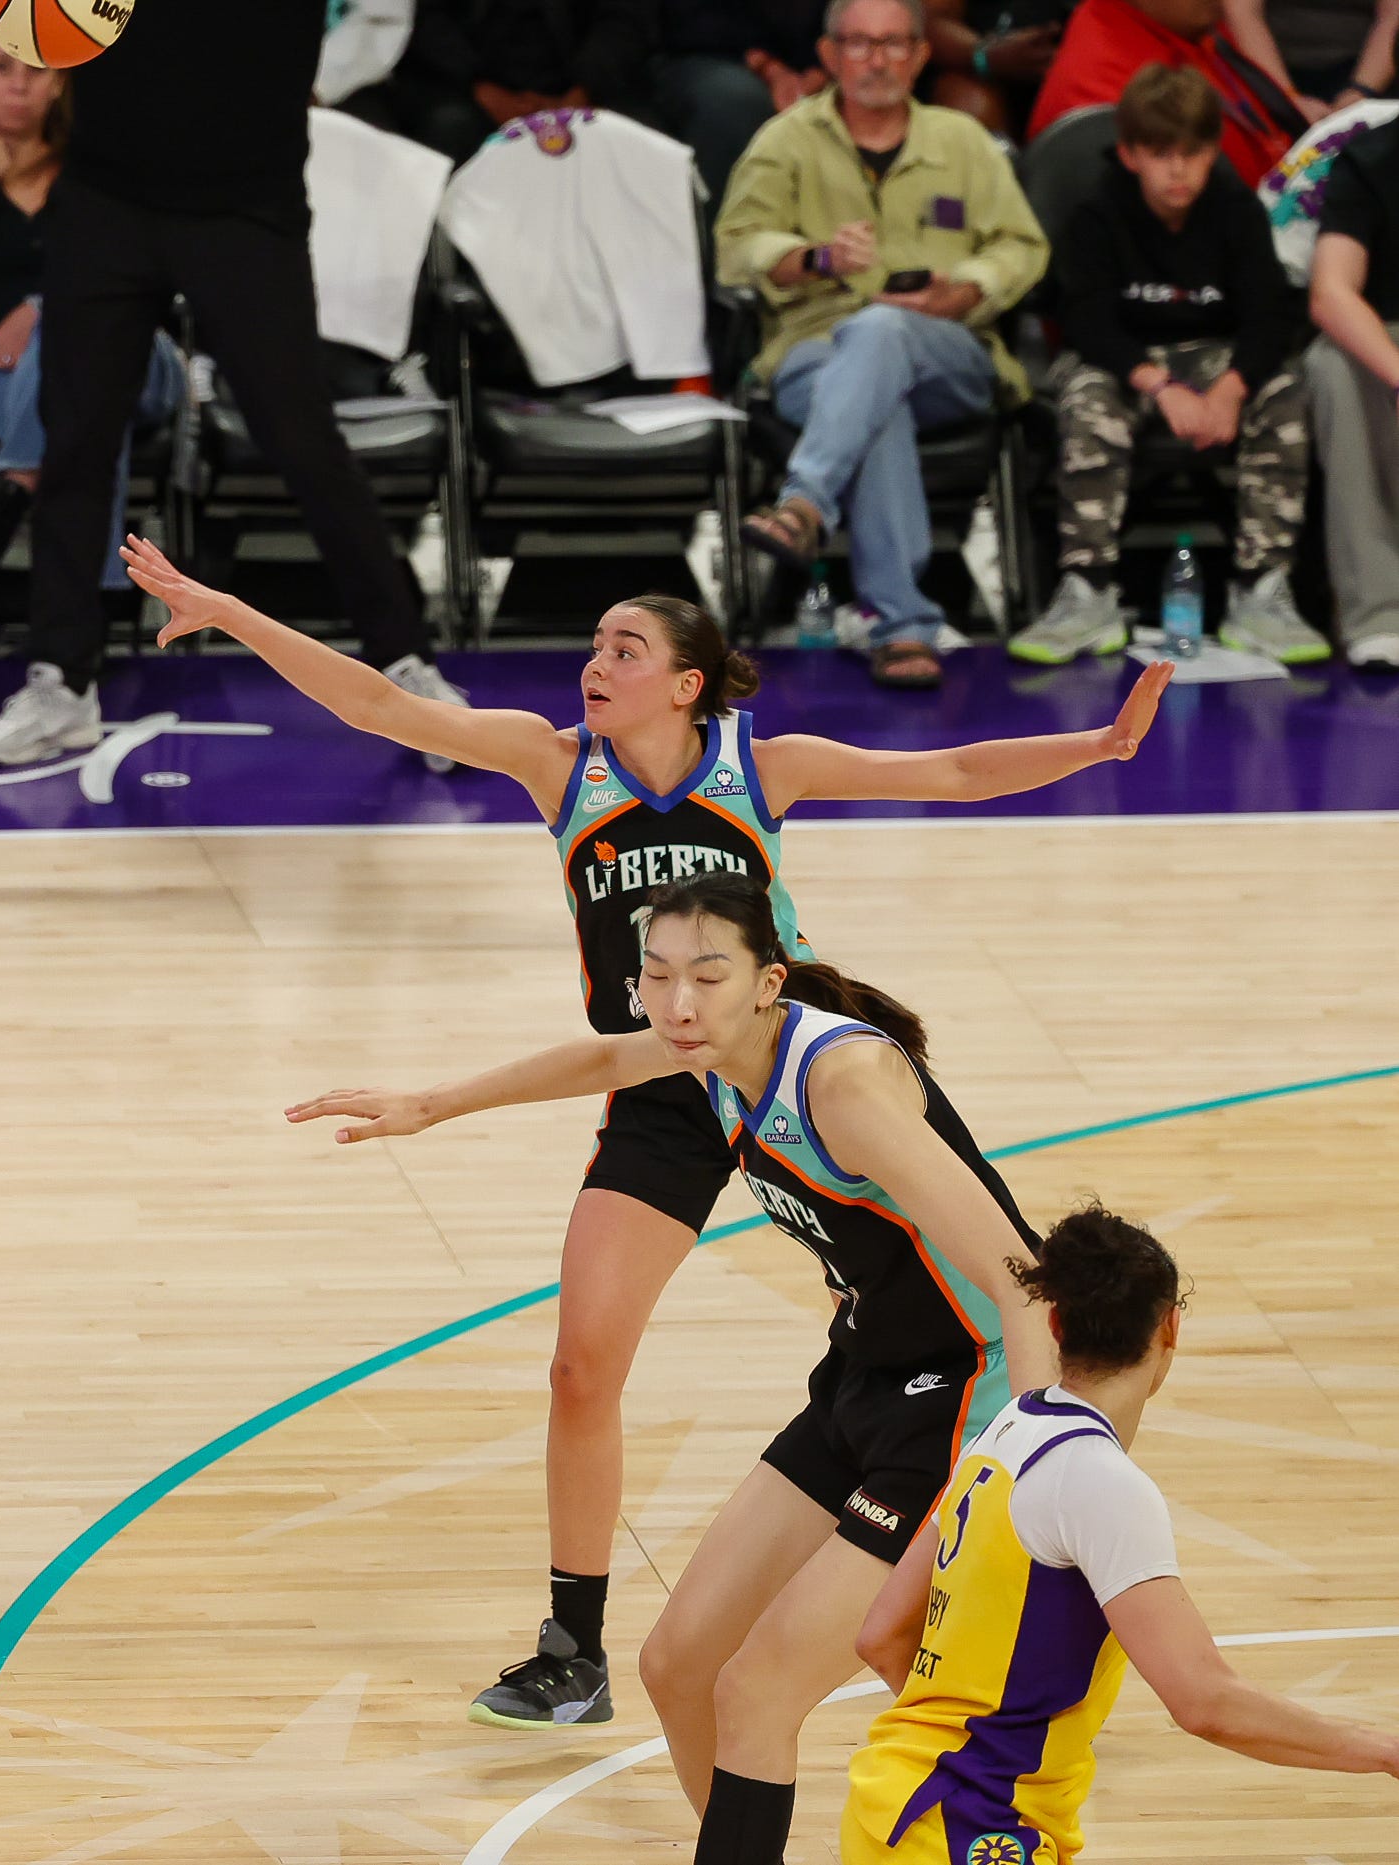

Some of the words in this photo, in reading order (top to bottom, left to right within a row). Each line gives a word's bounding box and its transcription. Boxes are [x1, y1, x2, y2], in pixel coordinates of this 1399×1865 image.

[589, 789, 619, 803] NIKE
[706, 786, 746, 797] BARCLAYS
[766, 1133, 801, 1144] BARCLAYS
[912, 1372, 943, 1388] NIKE
[849, 1491, 900, 1532] WNBA
[937, 1465, 996, 1572] 5
